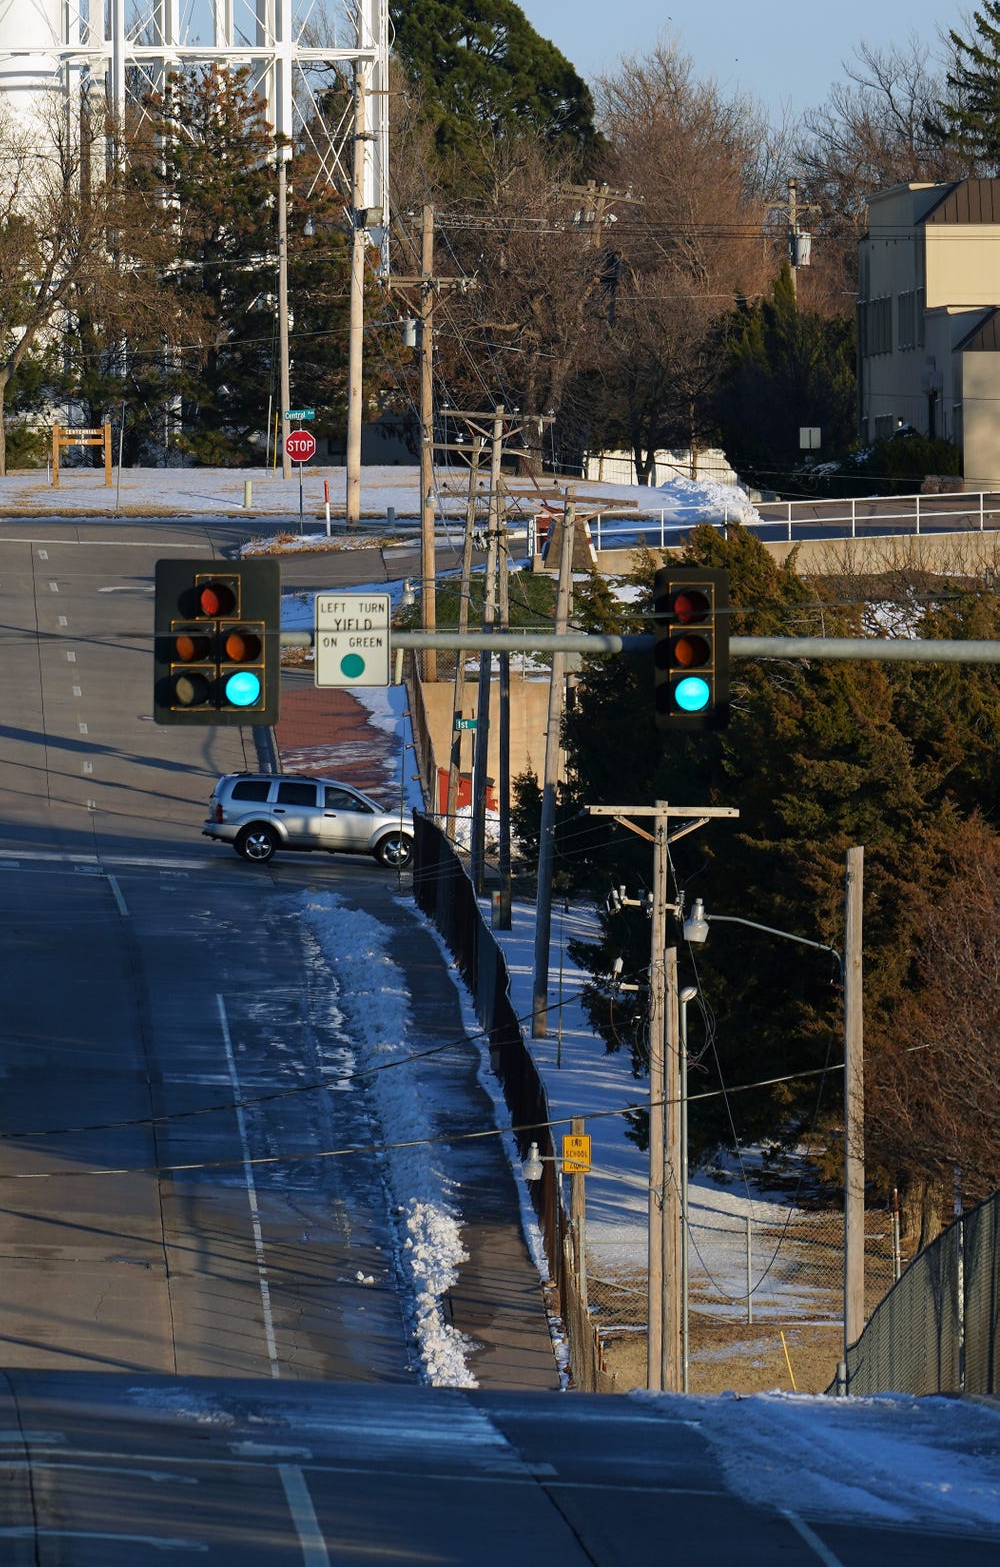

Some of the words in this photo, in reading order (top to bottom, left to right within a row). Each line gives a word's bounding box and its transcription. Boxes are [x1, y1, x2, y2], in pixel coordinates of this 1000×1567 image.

[285, 410, 305, 420] Central
[287, 440, 313, 452] STOP
[321, 602, 346, 613] LEFT
[359, 602, 385, 613] TURN
[334, 618, 373, 631] YIELD
[323, 637, 338, 647] ON
[349, 637, 383, 647] GREEN
[571, 1138, 583, 1147] END
[565, 1150, 588, 1158] SCHOOL
